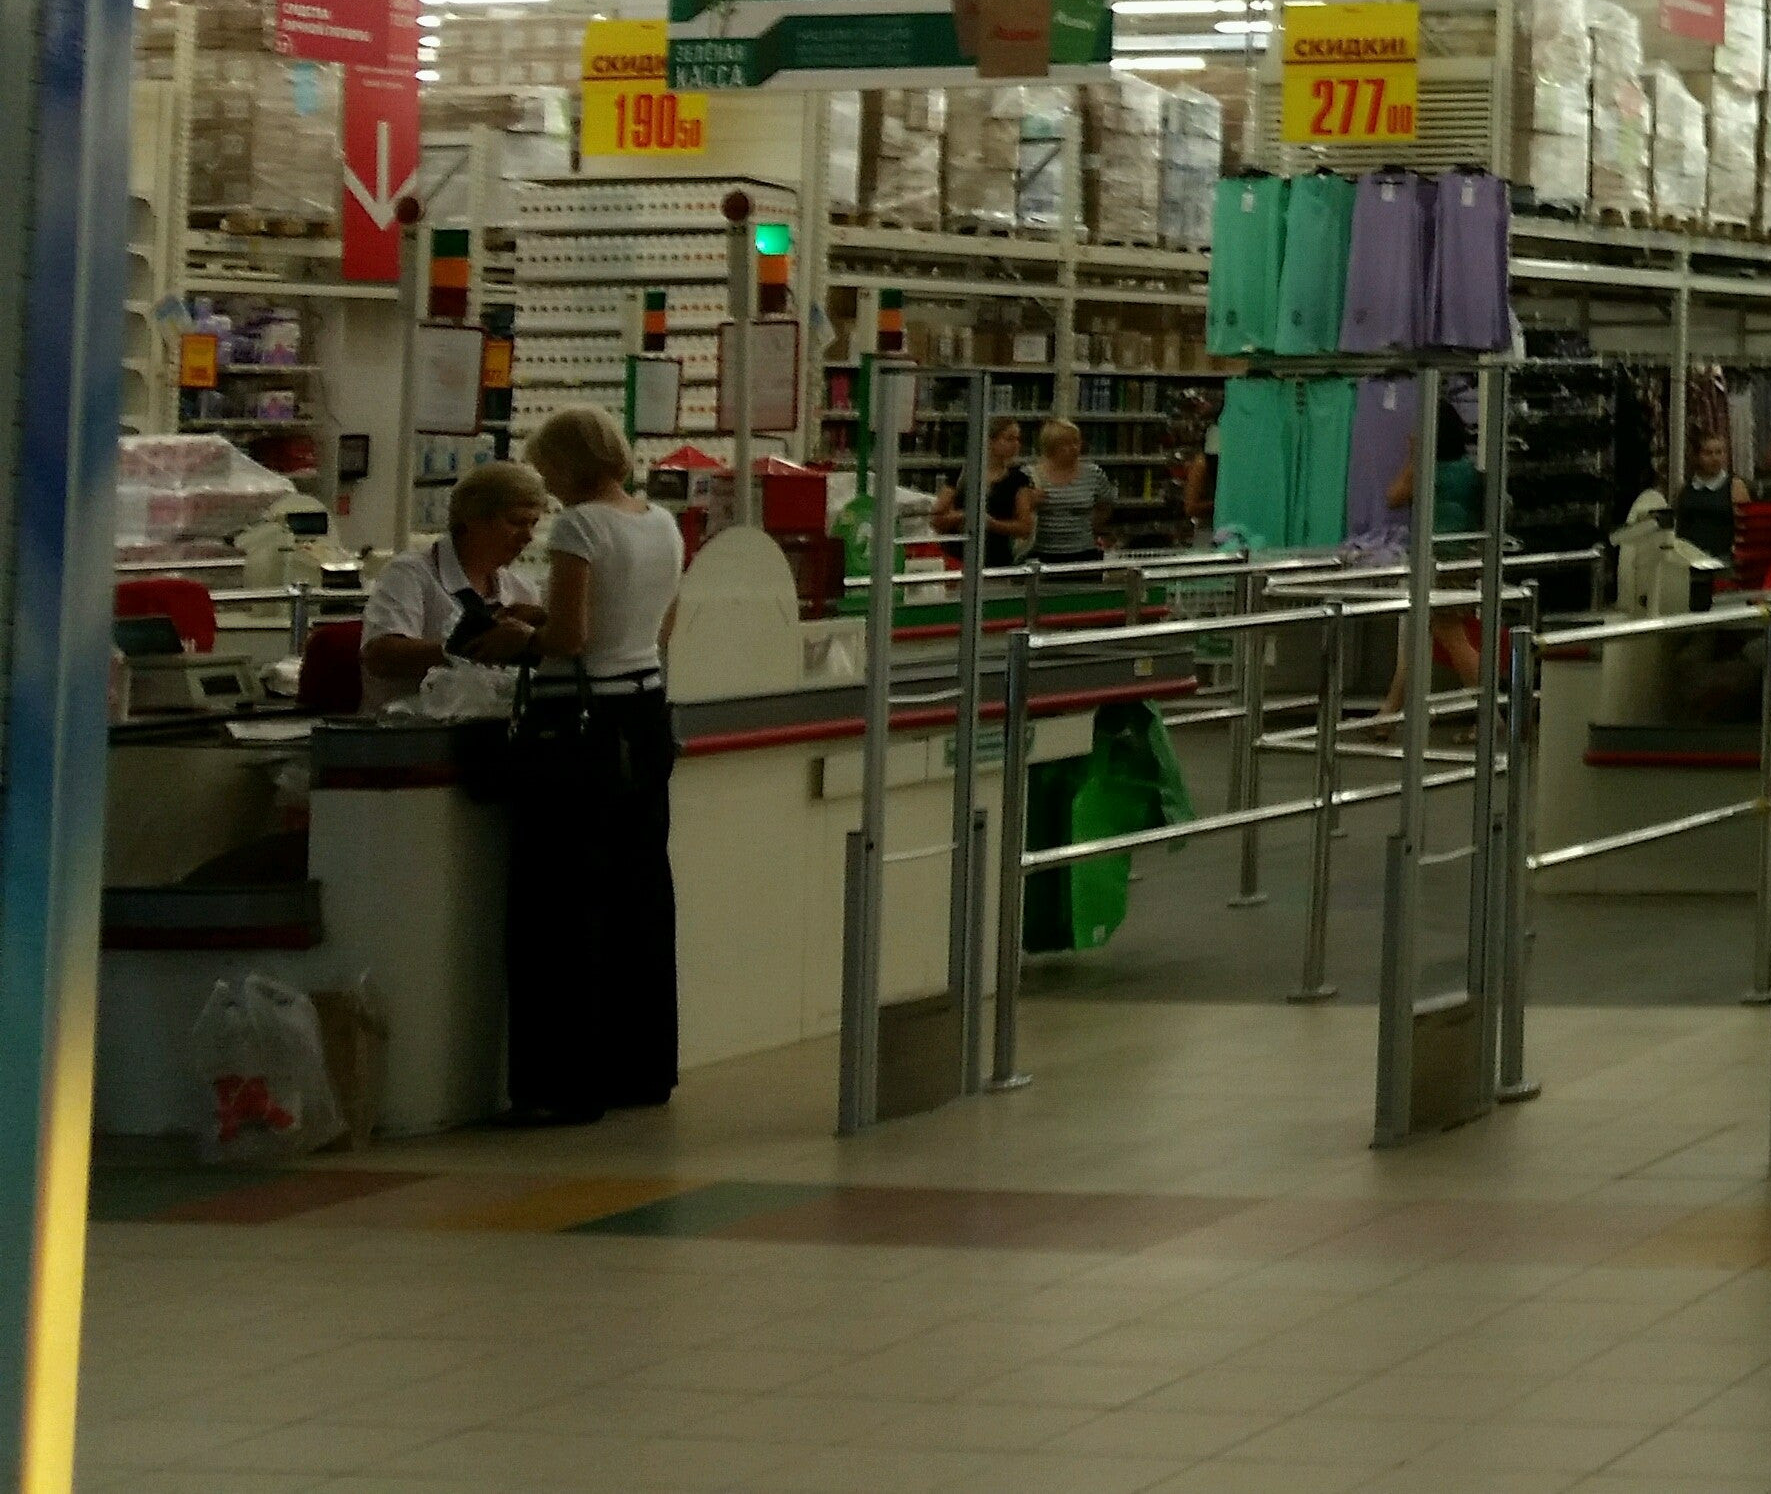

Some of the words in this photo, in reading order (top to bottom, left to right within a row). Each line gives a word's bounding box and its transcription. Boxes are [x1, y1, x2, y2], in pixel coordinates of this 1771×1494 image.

[1293, 36, 1408, 57] СКИДКИ!
[614, 93, 678, 149] 190
[678, 118, 702, 149] 50
[1310, 78, 1386, 136] 277
[1386, 105, 1413, 135] 00
